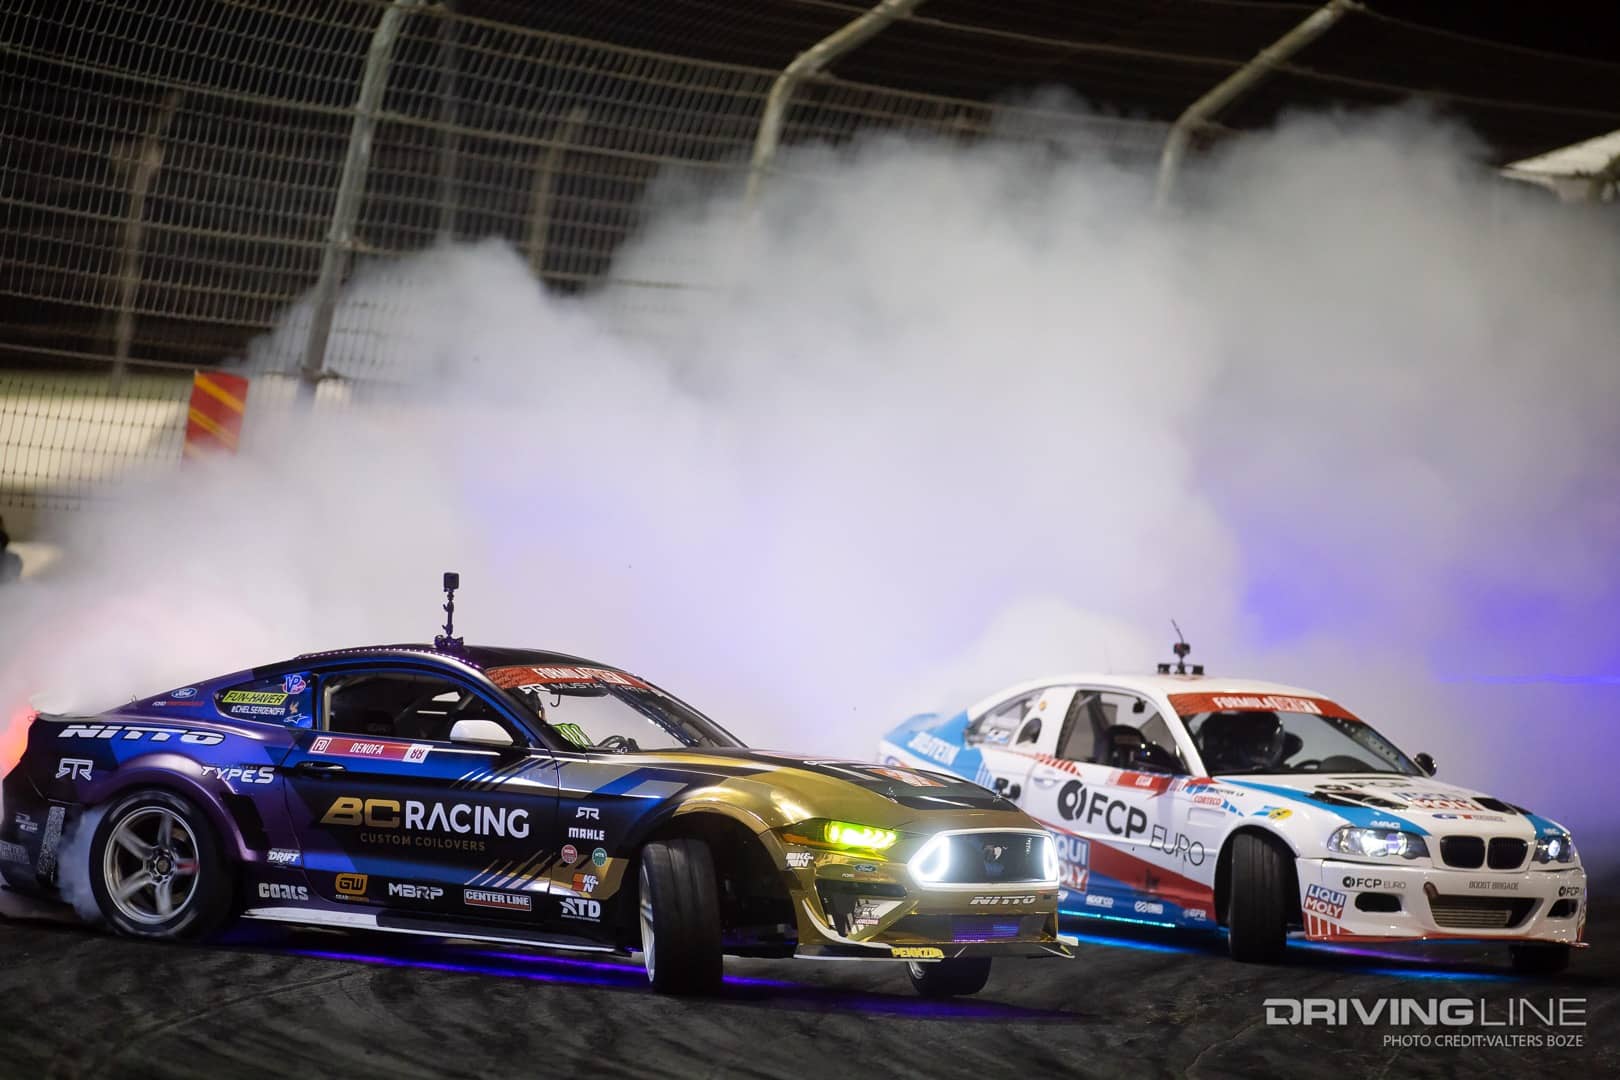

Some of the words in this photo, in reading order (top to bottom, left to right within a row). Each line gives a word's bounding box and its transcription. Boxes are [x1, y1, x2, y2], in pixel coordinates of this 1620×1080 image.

[225, 691, 285, 704] FUN-HAVER
[58, 725, 225, 746] NITTO
[349, 742, 385, 755] DENOFA
[410, 748, 425, 759] 88
[319, 796, 400, 829] BC
[405, 800, 530, 839] RACING
[568, 827, 605, 841] MAHLE
[1087, 792, 1148, 839] FCP
[1151, 824, 1205, 866] EURO
[360, 832, 411, 846] CUSTOM
[415, 835, 486, 851] COILOVERS
[1055, 835, 1087, 865] QUI
[267, 851, 300, 863] DRIFT
[1059, 863, 1088, 888] OLY
[1356, 878, 1382, 889] FCP
[1384, 880, 1407, 889] EURO
[388, 882, 444, 900] MBRP
[465, 890, 504, 904] CENTER
[506, 895, 530, 906] LINE
[1308, 885, 1346, 905] LIQUI
[969, 896, 1036, 905] NITTO
[1305, 896, 1343, 918] MOLY
